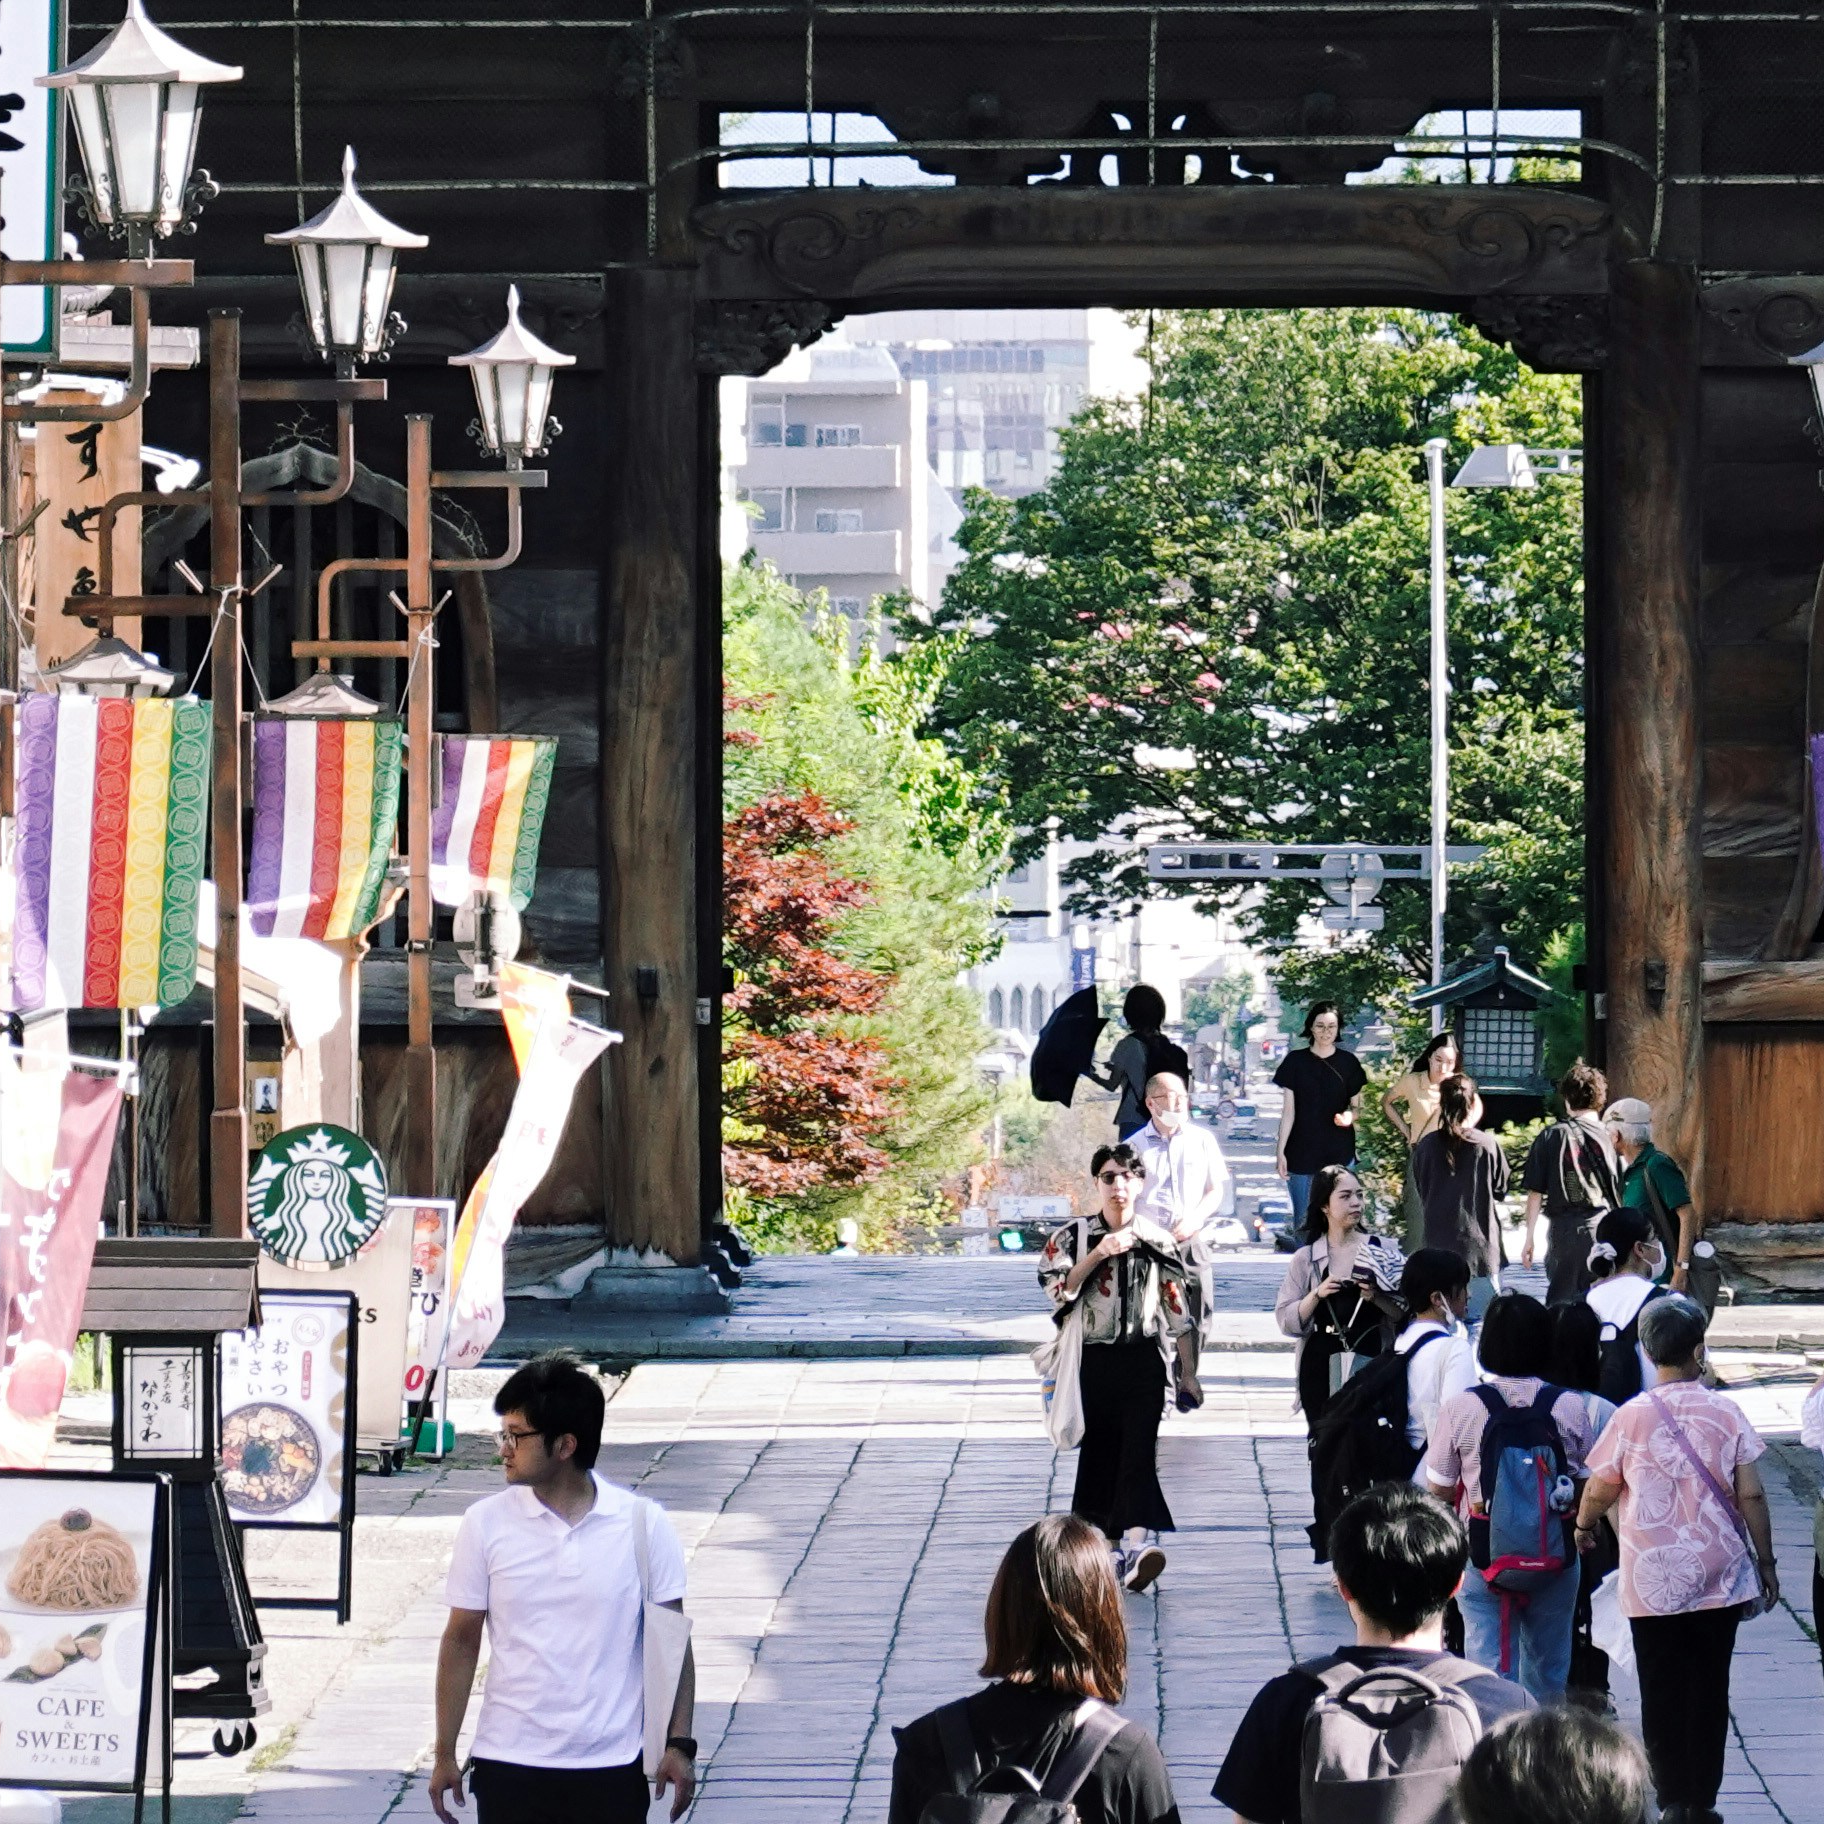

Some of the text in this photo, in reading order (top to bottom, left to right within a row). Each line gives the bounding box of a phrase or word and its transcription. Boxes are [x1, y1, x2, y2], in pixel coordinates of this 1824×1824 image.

[246, 1338, 266, 1396] やさい
[270, 1338, 290, 1396] おやつ
[139, 1379, 162, 1443] なかざわ
[37, 1696, 105, 1718] CAFE
[63, 1719, 74, 1730] &
[16, 1729, 119, 1753] SWEETS
